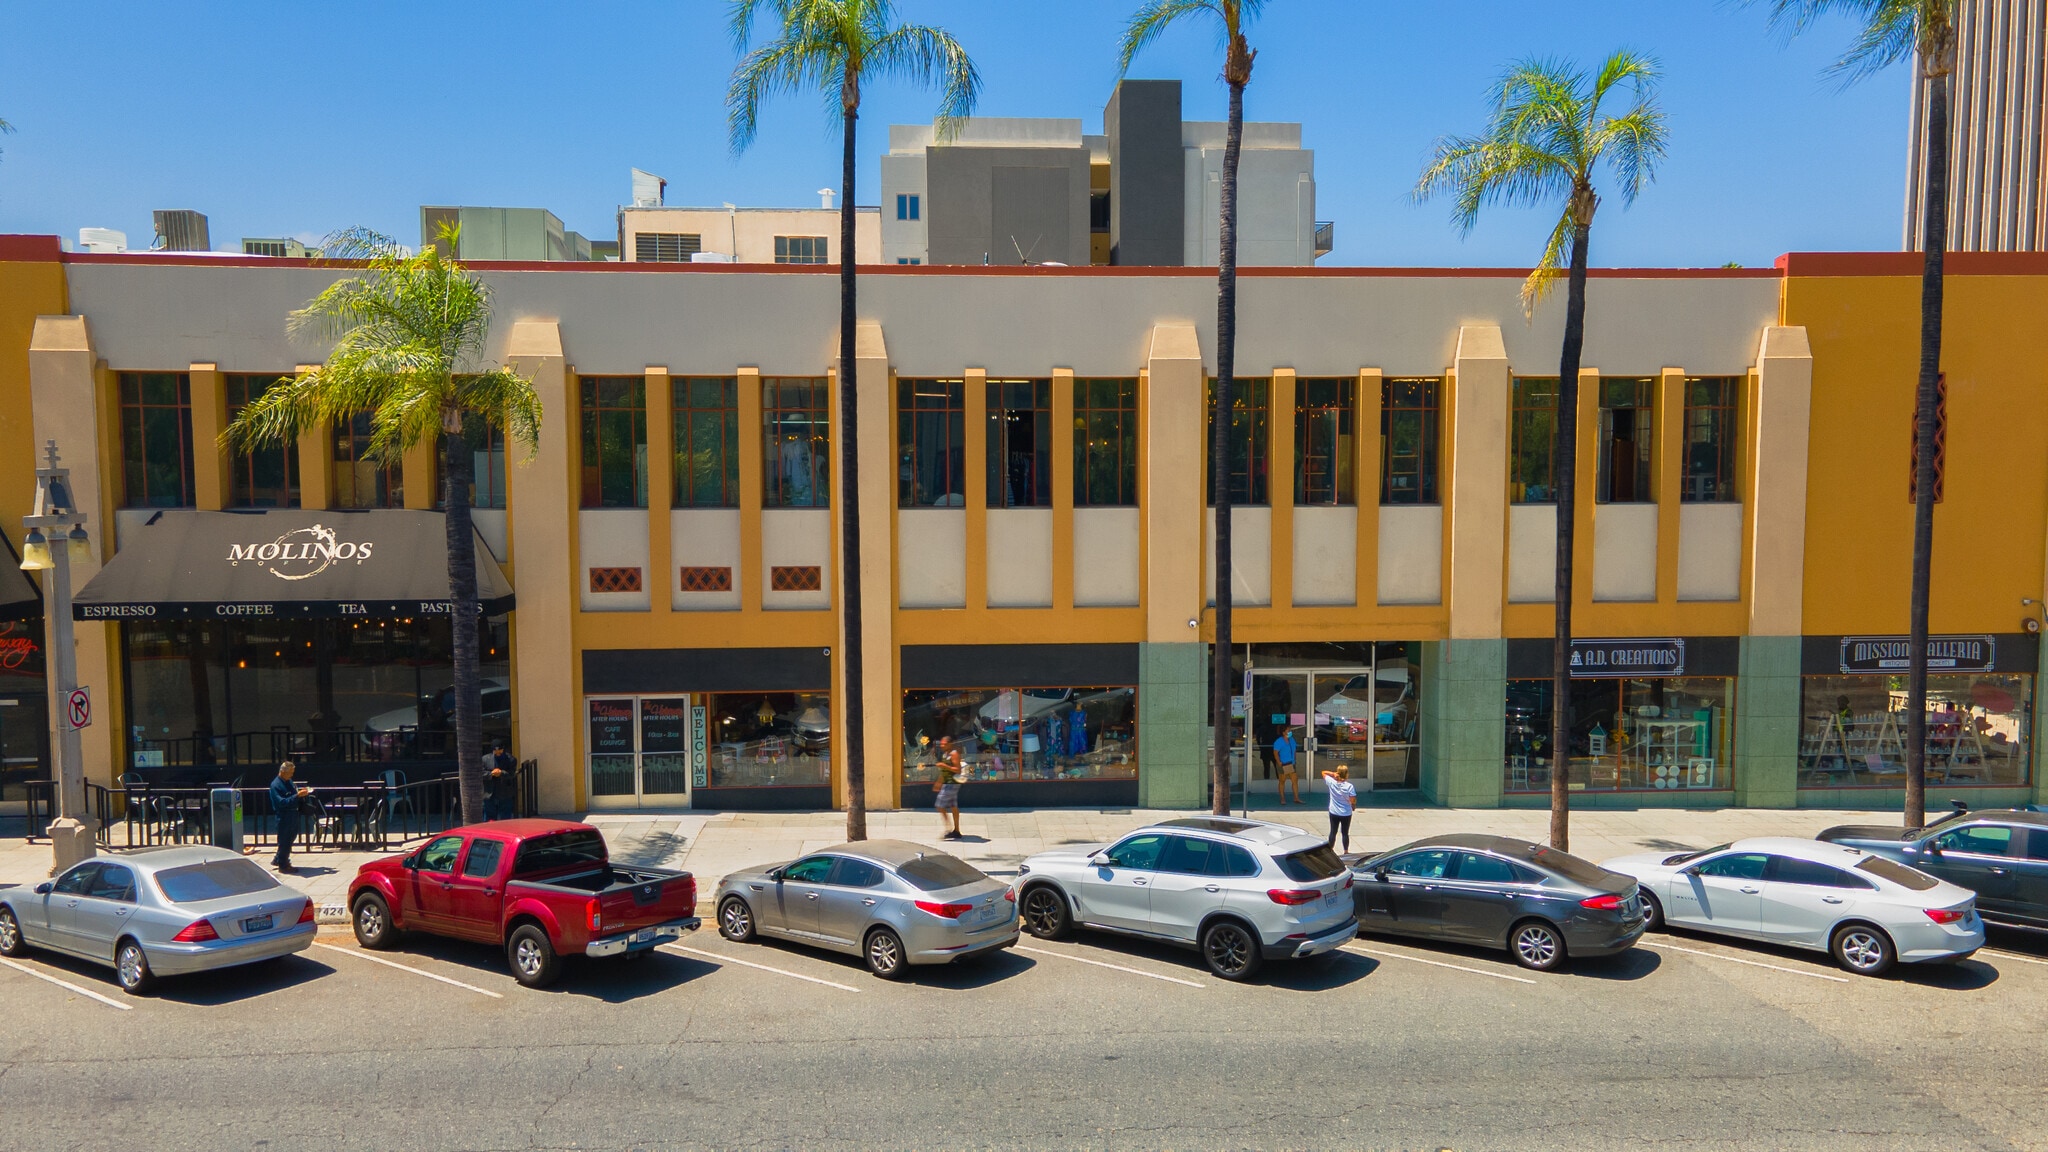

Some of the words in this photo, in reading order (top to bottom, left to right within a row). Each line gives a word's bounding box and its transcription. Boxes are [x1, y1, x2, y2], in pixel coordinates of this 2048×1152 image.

[227, 542, 374, 560] MOLINOS
[83, 605, 156, 617] ESPRESSO
[216, 604, 274, 616] COFFEE
[338, 603, 368, 615] TEA
[420, 602, 484, 614] PASTS
[1585, 650, 1607, 666] A.D.
[1611, 649, 1677, 665] CREATIONS
[1855, 643, 1911, 662] MISSION
[1927, 642, 1981, 660] ALLERIA
[693, 708, 704, 785] WELCOME
[137, 755, 147, 763] A
